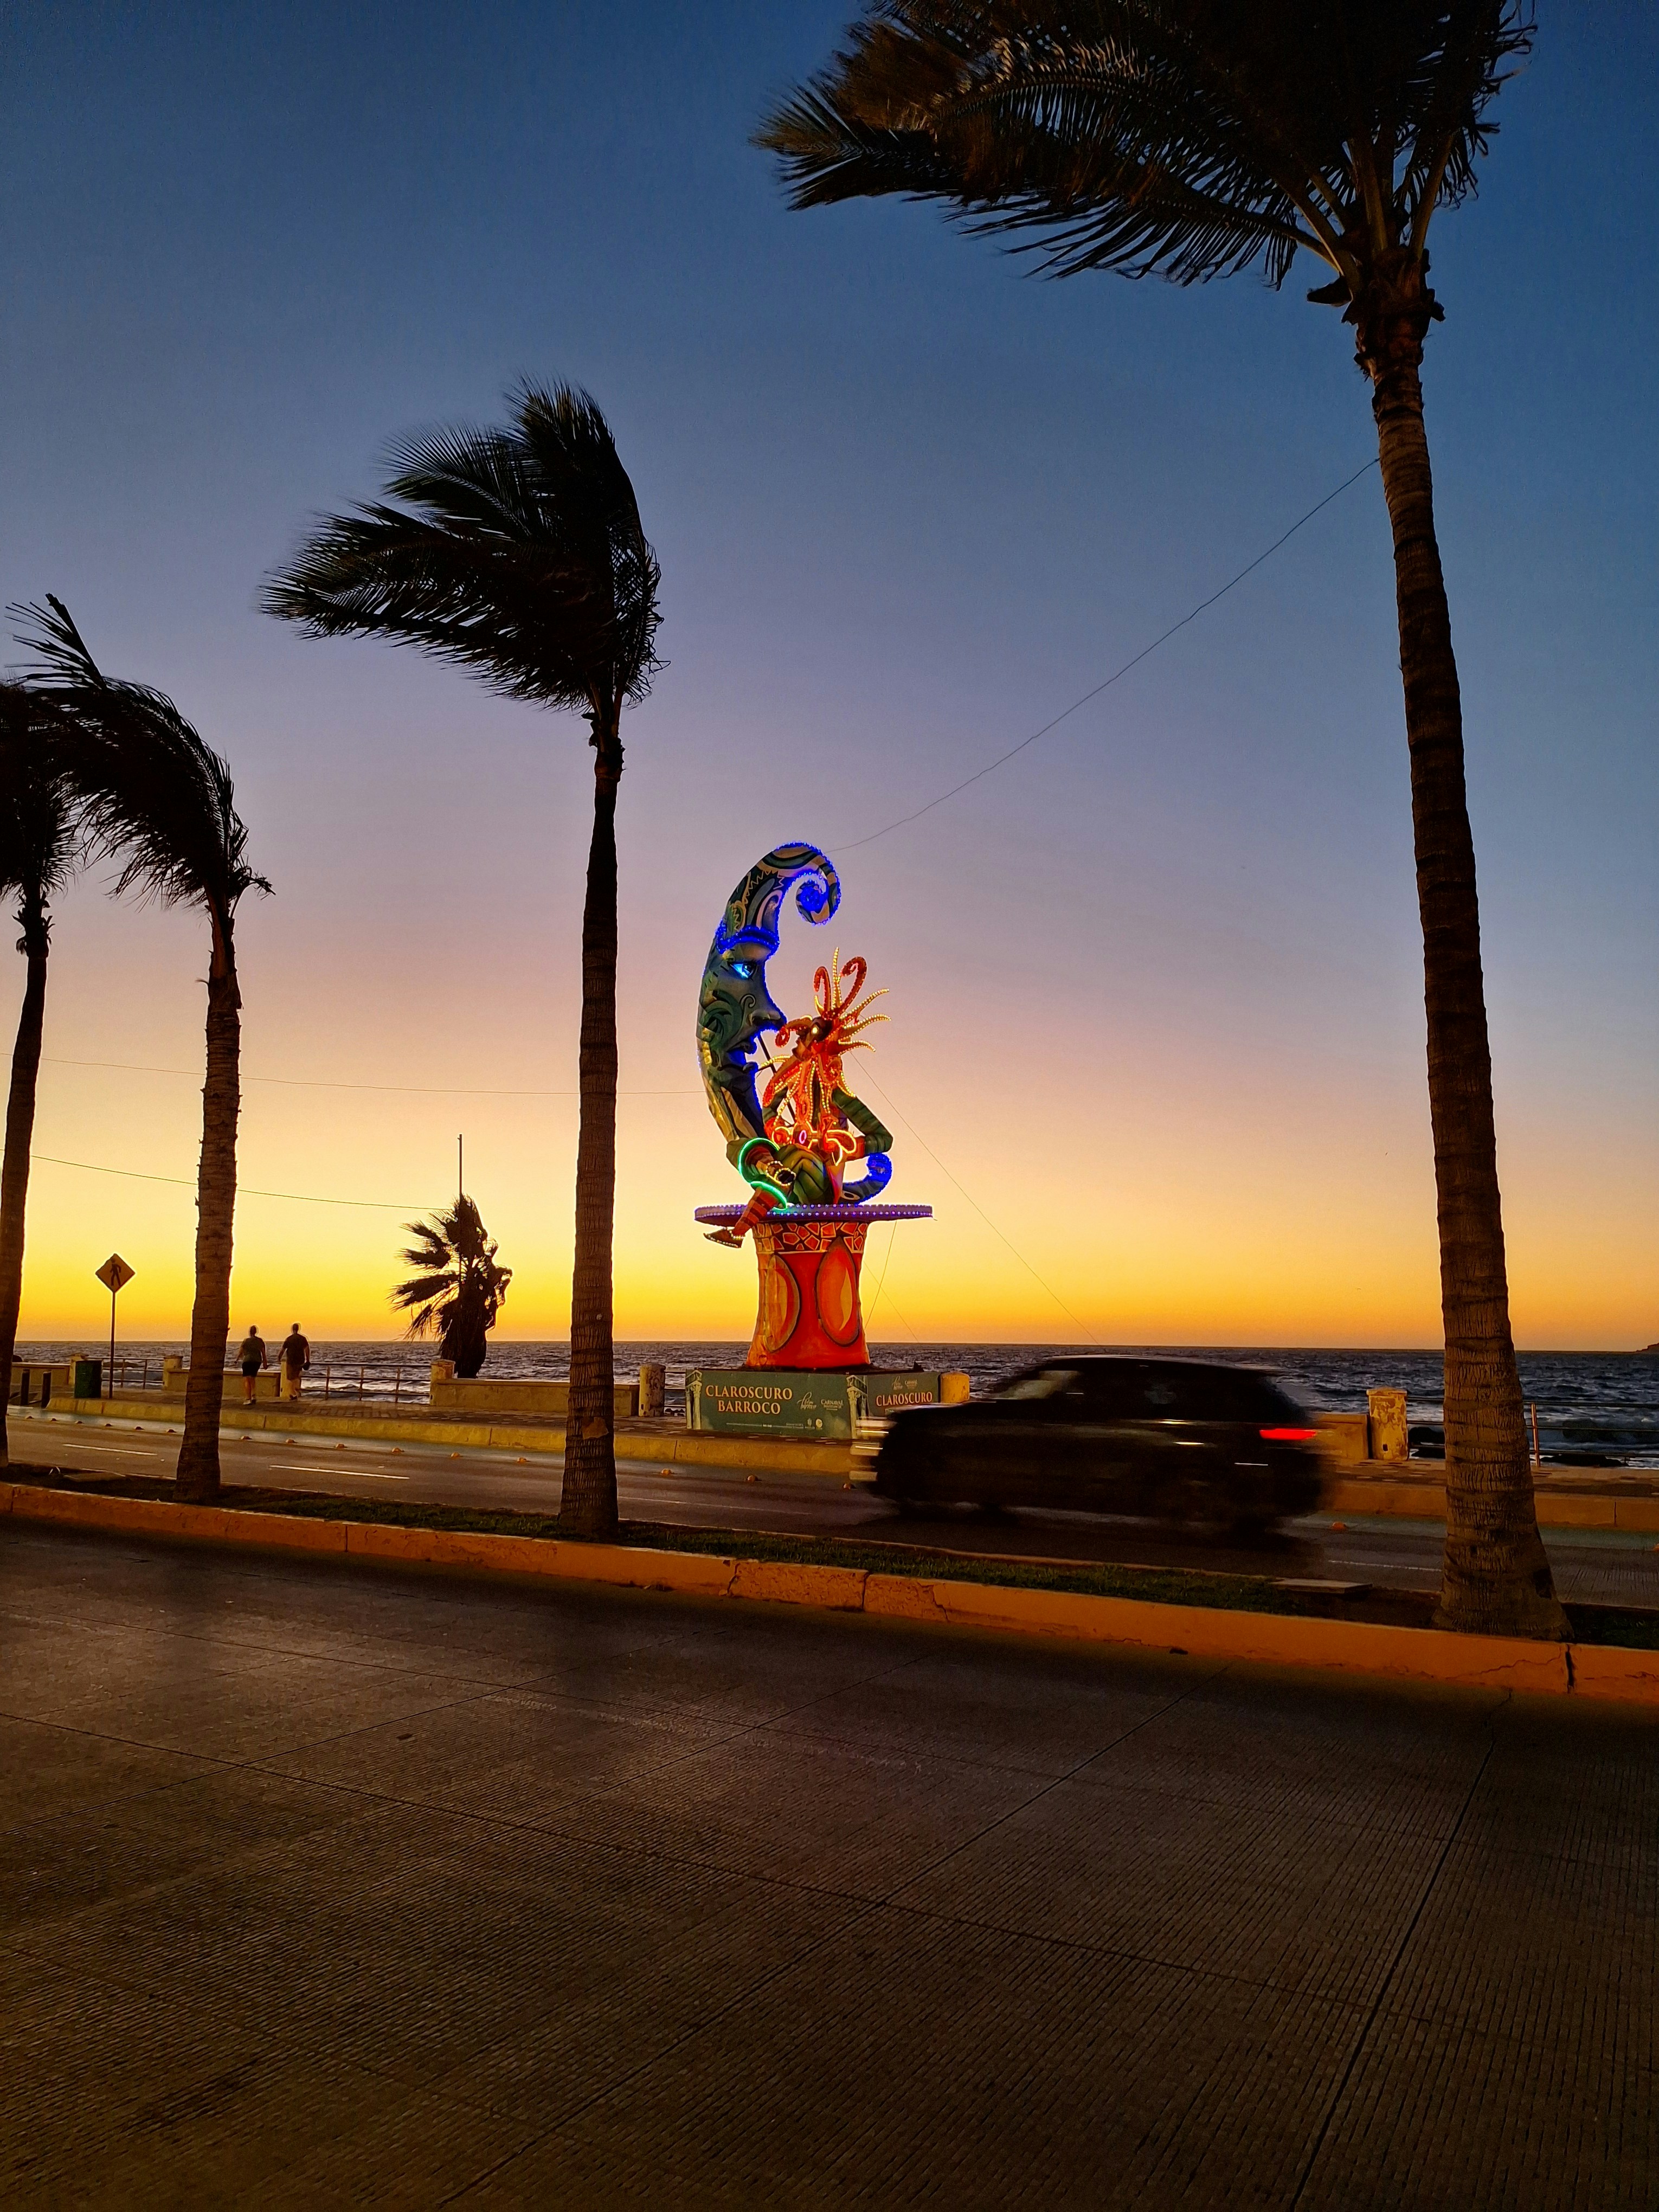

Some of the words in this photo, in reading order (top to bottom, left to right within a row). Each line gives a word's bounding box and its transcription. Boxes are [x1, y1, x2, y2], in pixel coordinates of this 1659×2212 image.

[705, 1385, 793, 1400] CLAROSCURO
[876, 1391, 933, 1406] CLAROSCURO
[718, 1400, 781, 1414] BARROCO
